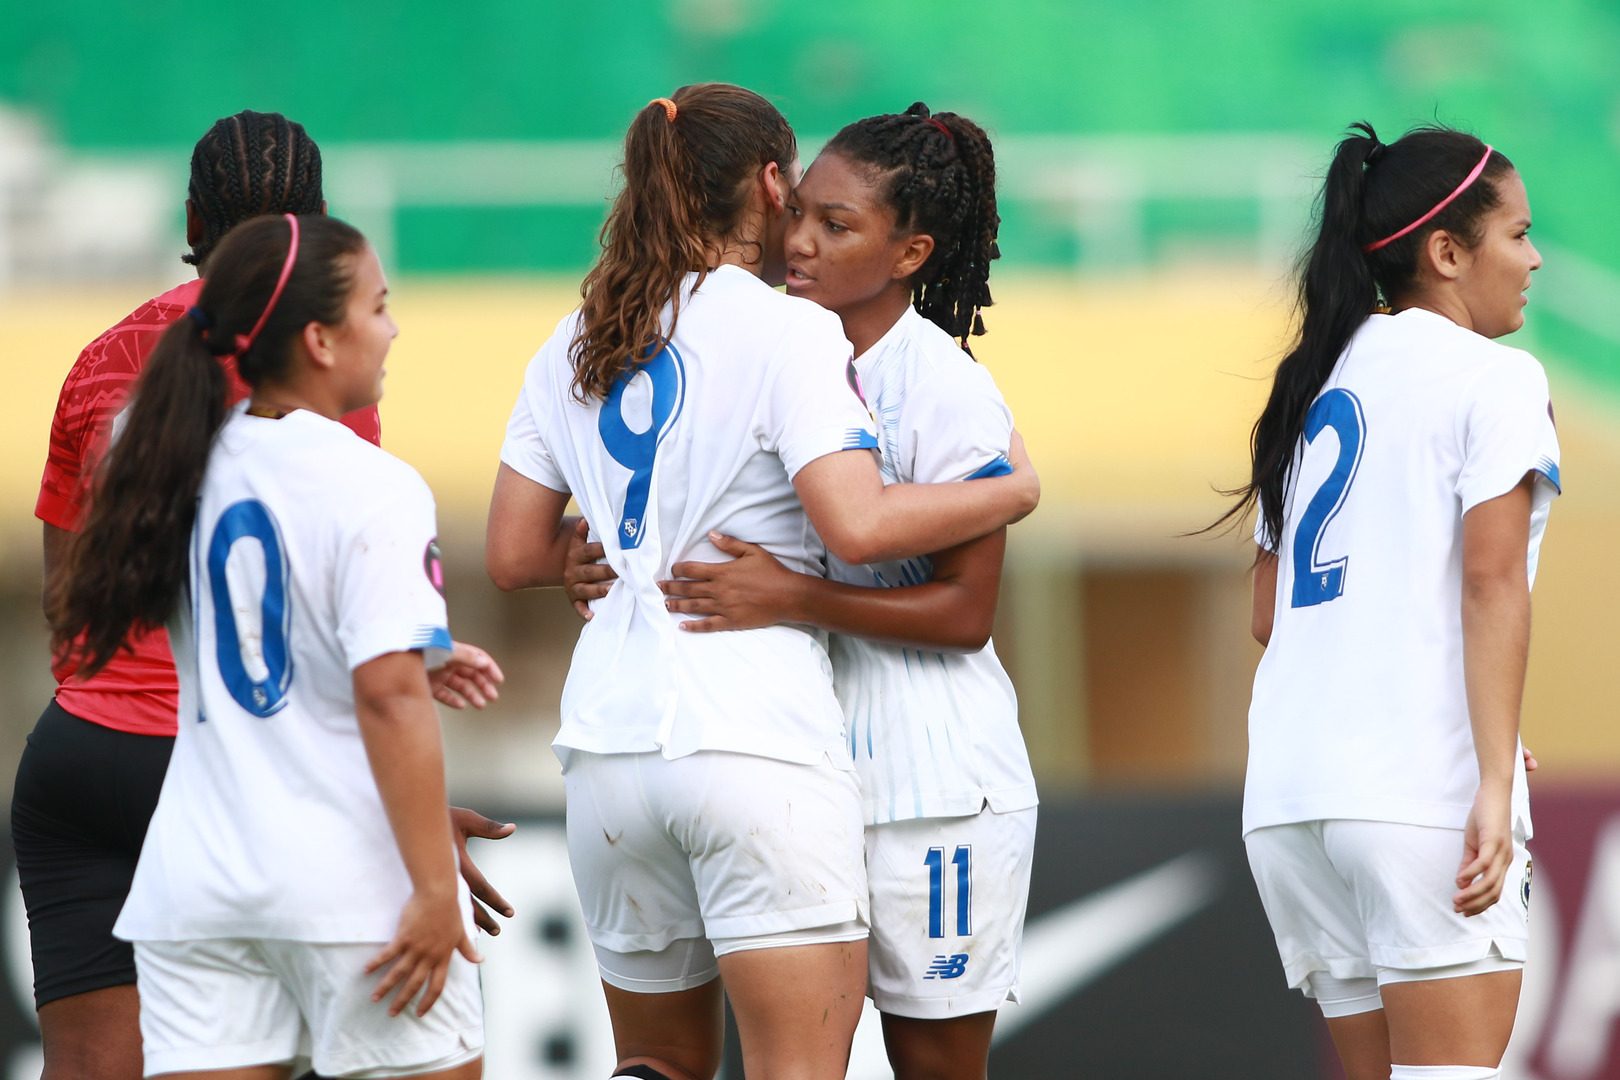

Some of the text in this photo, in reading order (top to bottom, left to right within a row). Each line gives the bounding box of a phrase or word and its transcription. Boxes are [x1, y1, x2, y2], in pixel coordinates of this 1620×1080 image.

[598, 337, 686, 550] 9
[1291, 388, 1367, 608] 2
[189, 497, 294, 722] 0
[923, 843, 973, 939] 11
[923, 953, 969, 980] NB
